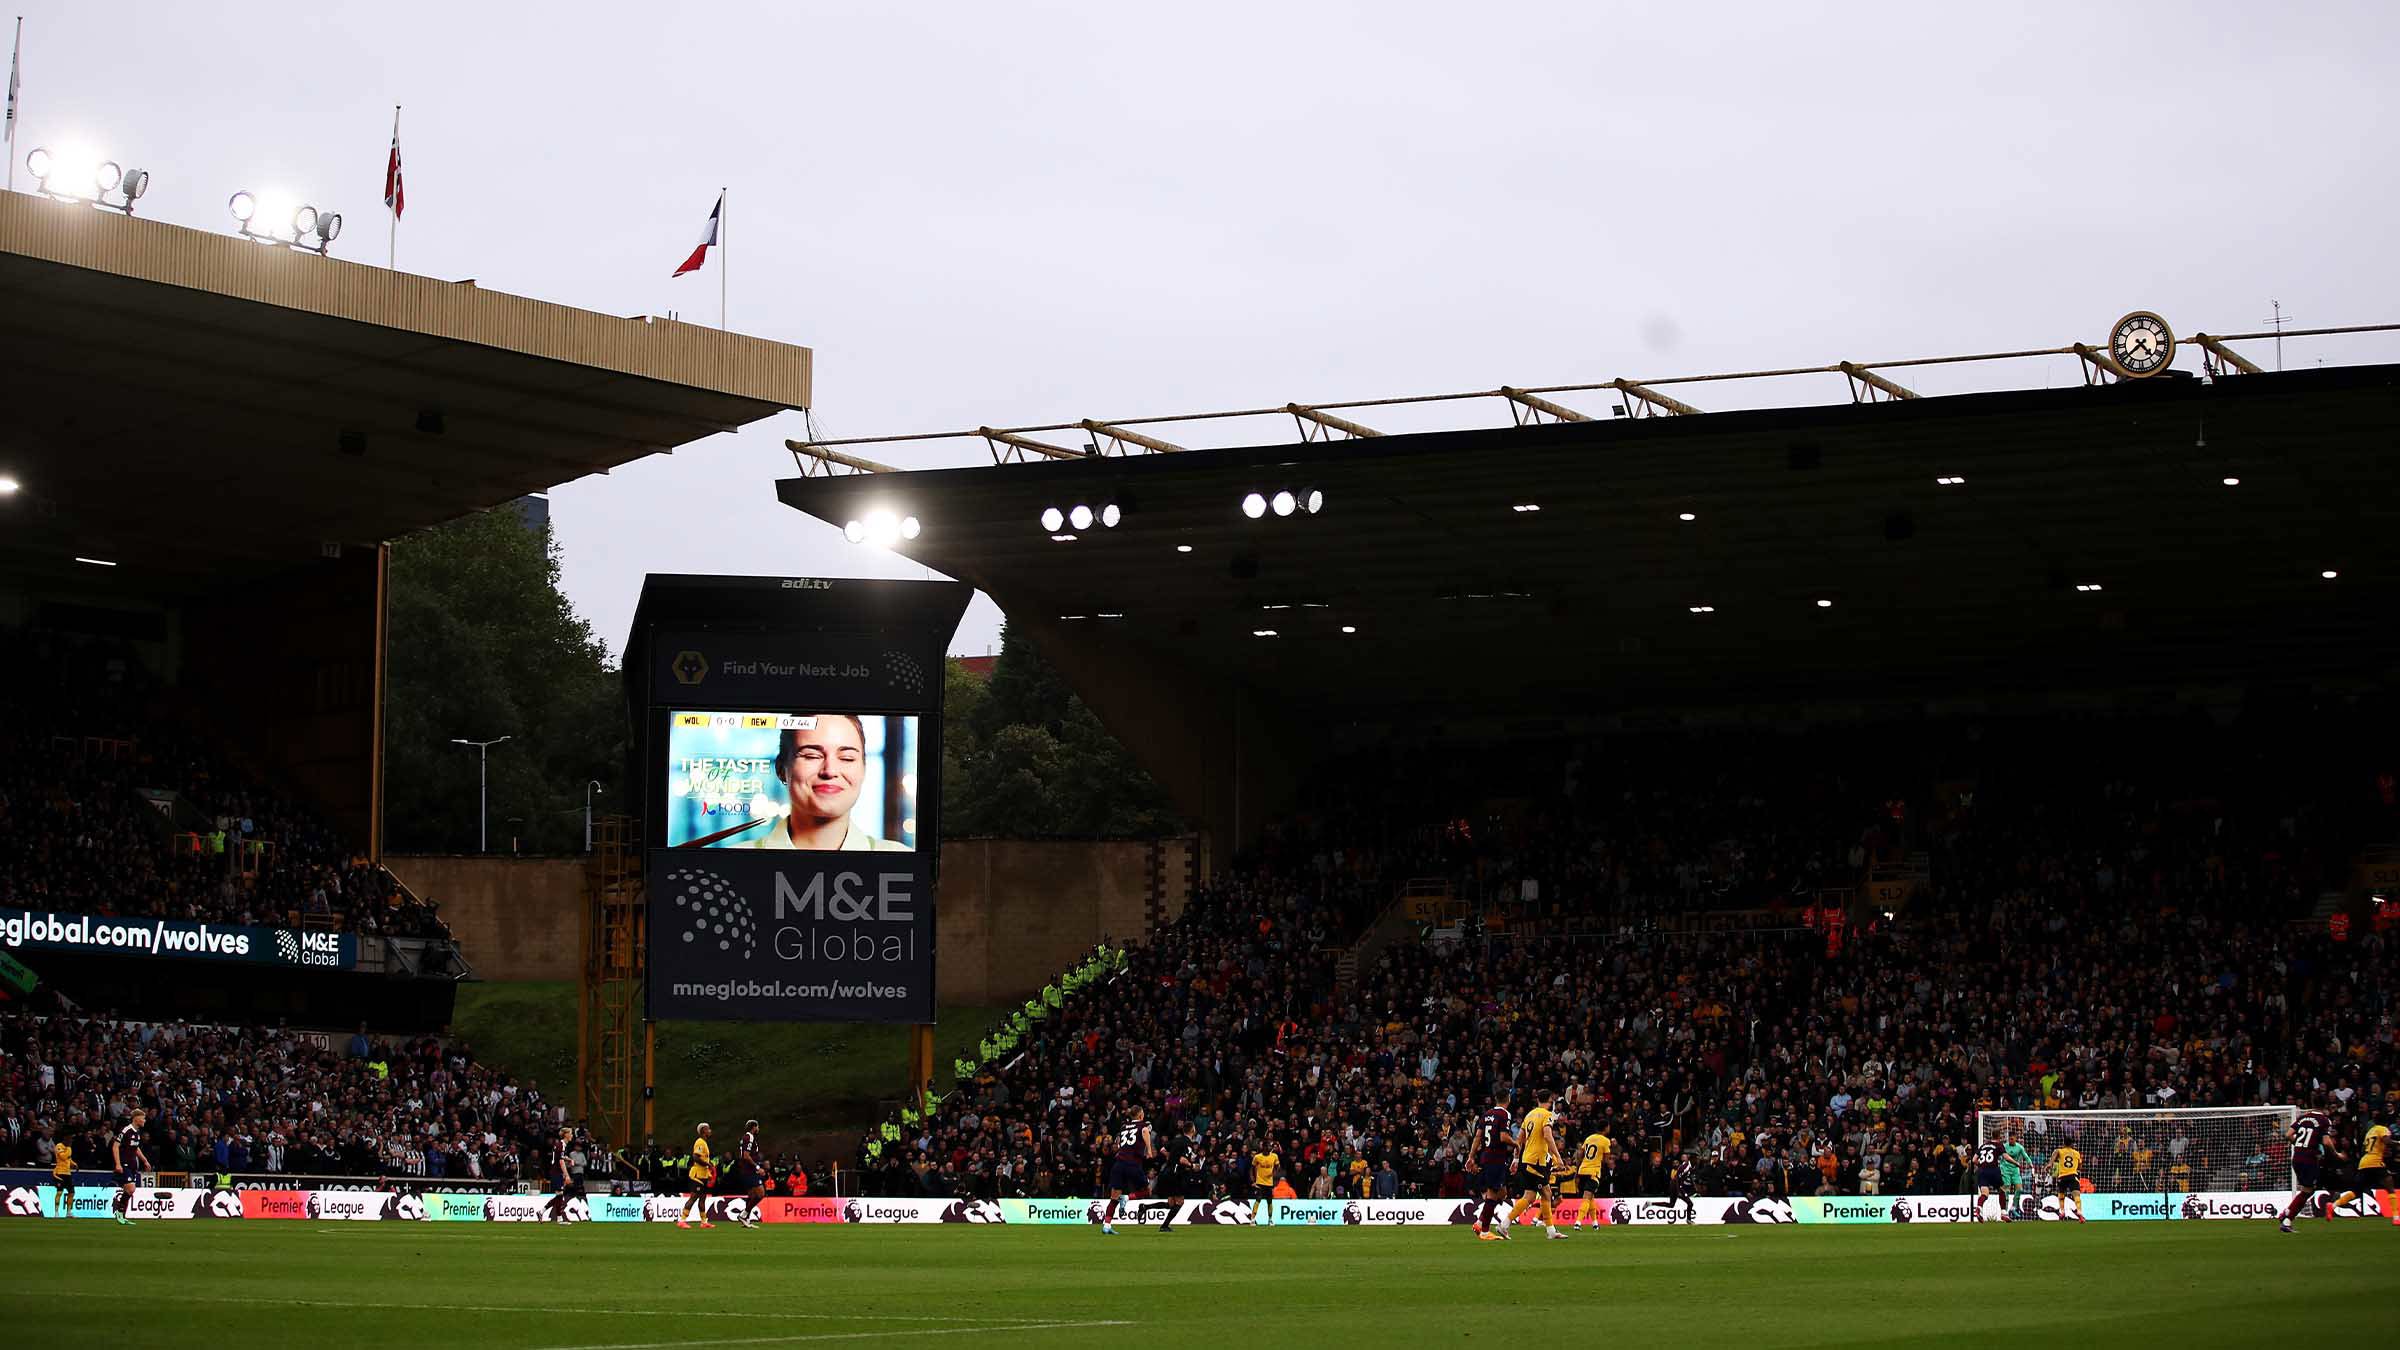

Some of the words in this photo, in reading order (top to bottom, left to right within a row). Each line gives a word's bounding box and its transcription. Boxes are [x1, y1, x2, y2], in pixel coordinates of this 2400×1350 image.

[781, 578, 834, 590] adi.tv
[723, 661, 756, 676] Find
[759, 662, 795, 676] Your
[799, 663, 836, 677] Next
[840, 664, 870, 678] Job
[681, 757, 713, 773] THE
[716, 758, 771, 774] TASTE
[689, 779, 763, 793] WONDER
[718, 803, 751, 813] FOOD
[775, 871, 914, 921] M&E
[302, 932, 339, 952] M&E
[774, 926, 914, 961] Global
[302, 952, 339, 967] Global
[673, 979, 907, 1001] mneglobal.com/wolves
[1120, 1127, 1138, 1147] 33
[1484, 1124, 1493, 1147] 5
[2295, 1127, 2314, 1148] 21
[1978, 1149, 1995, 1165] 36
[2063, 1155, 2074, 1169] 8
[142, 1177, 154, 1188] 15
[131, 1193, 175, 1216] League
[261, 1197, 303, 1213] Premier
[324, 1198, 365, 1219] League
[443, 1200, 480, 1216] Premier
[498, 1201, 535, 1221] League
[606, 1202, 641, 1217] Premier
[784, 1203, 838, 1217] Premier
[866, 1204, 919, 1223] League
[1028, 1204, 1082, 1219] Premier
[1823, 1202, 1885, 1218] Premier
[2111, 1199, 2176, 1216] Premier
[2209, 1199, 2275, 1219] League
[1280, 1205, 1338, 1221] Premier
[1367, 1206, 1425, 1225] League
